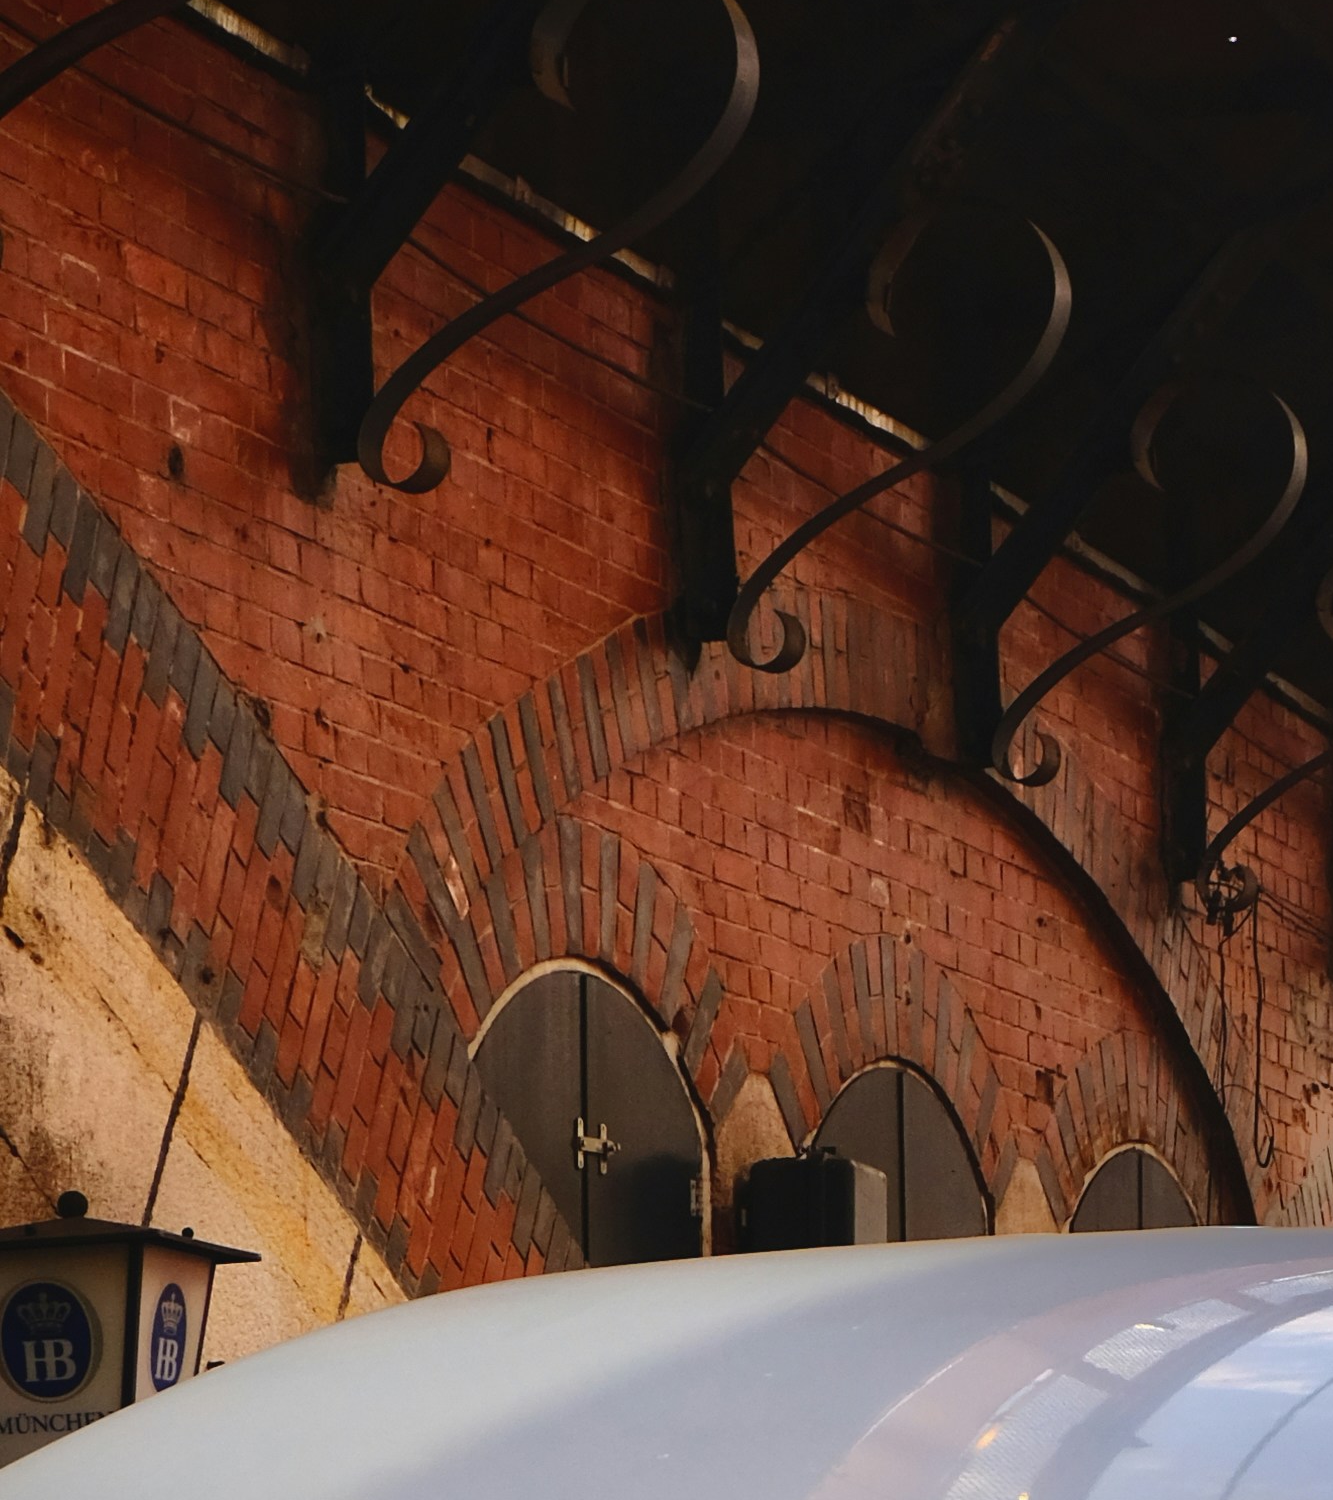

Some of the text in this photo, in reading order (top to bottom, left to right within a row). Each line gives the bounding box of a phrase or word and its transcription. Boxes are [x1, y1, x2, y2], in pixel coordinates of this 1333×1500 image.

[22, 1337, 78, 1384] HB
[154, 1336, 179, 1382] HB
[0, 1411, 114, 1435] MÜNCHE
